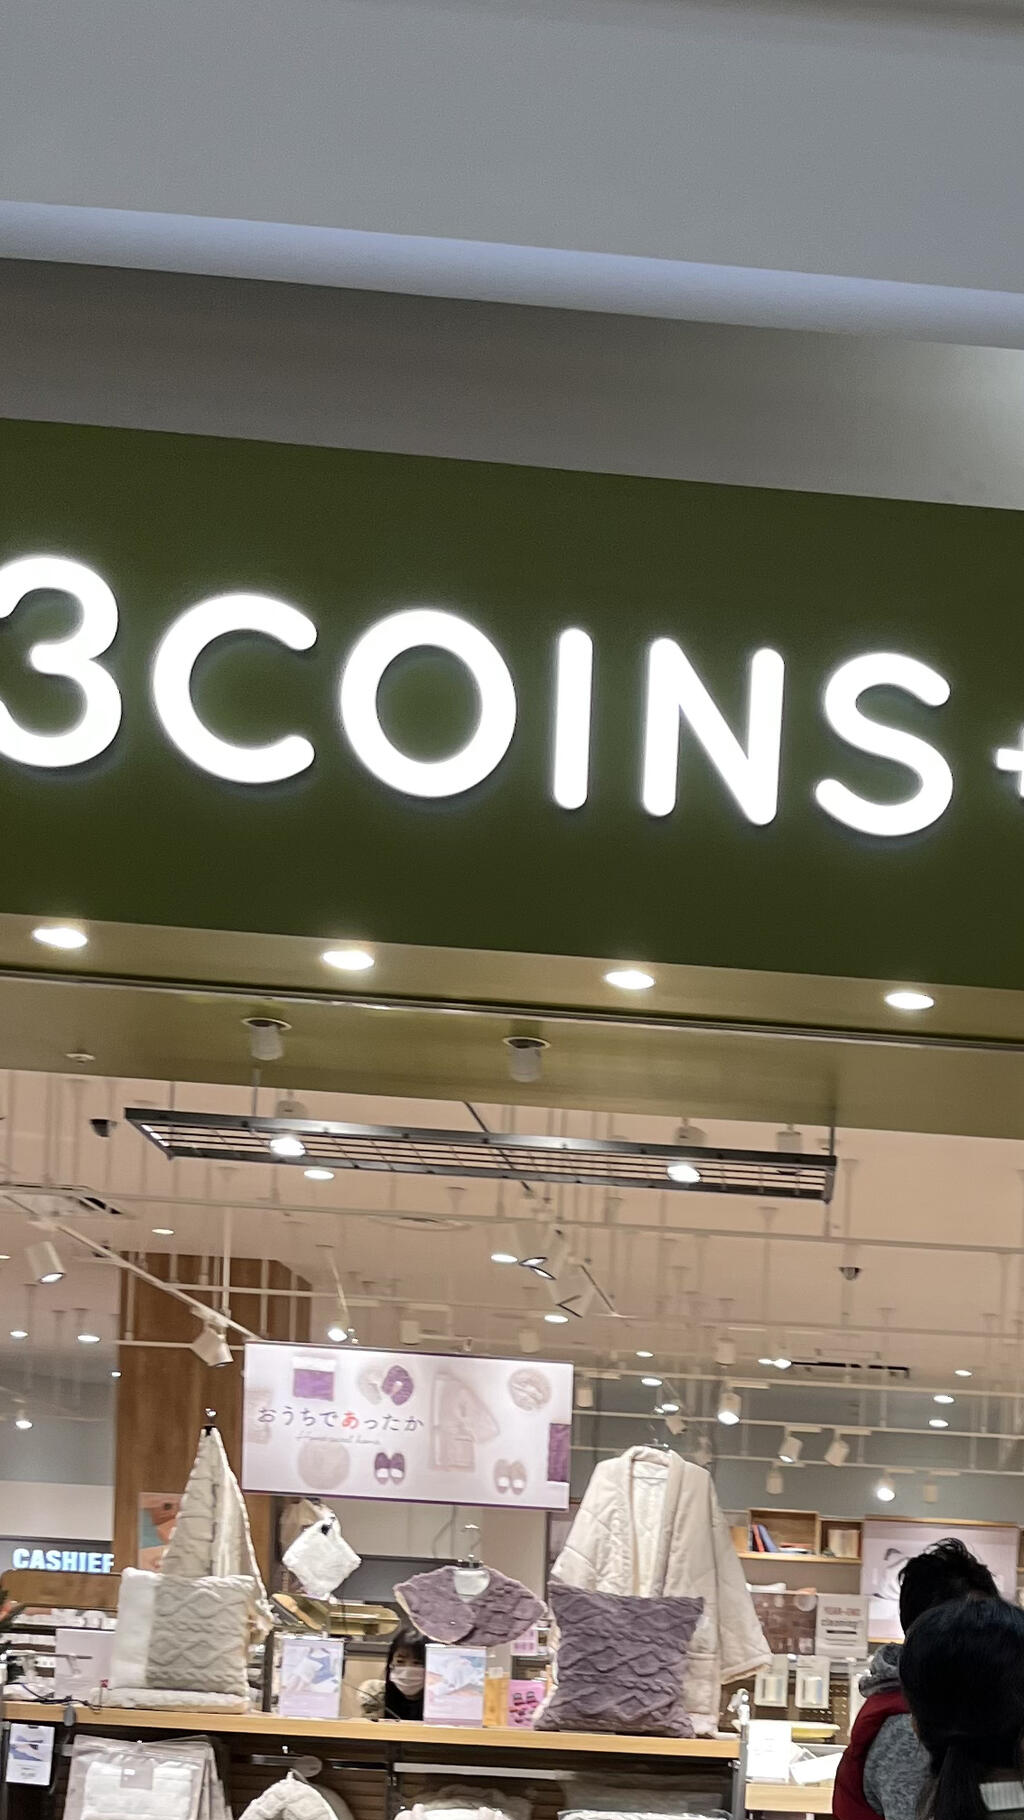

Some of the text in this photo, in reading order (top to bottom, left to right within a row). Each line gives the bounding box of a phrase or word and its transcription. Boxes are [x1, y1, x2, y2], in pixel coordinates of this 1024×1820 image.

[0, 556, 954, 837] 3COINS
[257, 1406, 424, 1432] おうちであったか
